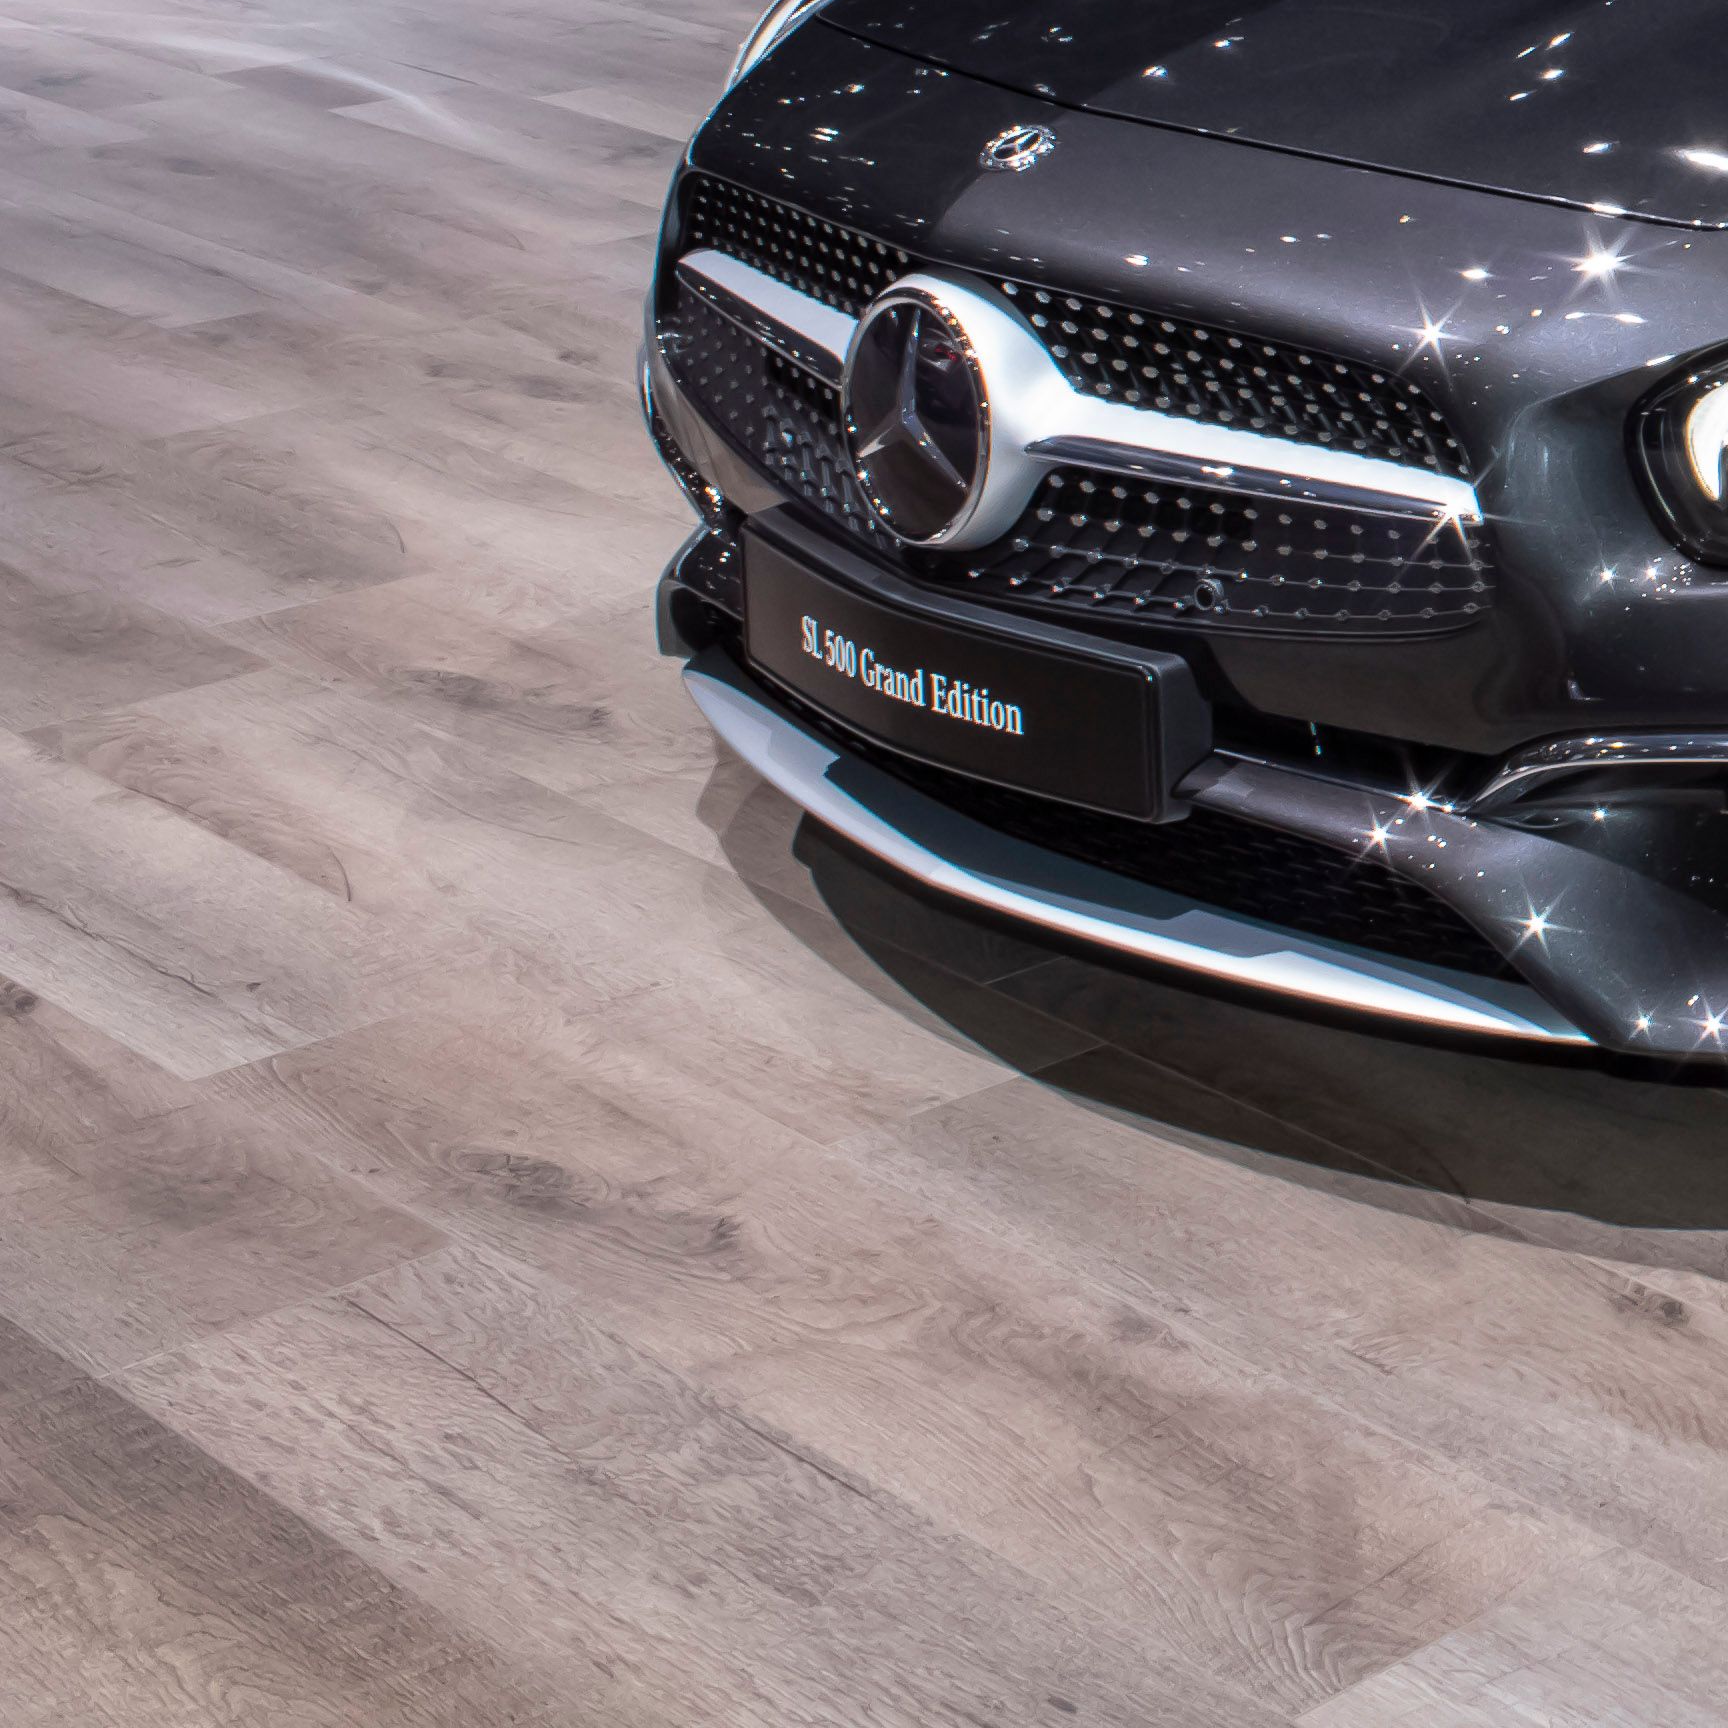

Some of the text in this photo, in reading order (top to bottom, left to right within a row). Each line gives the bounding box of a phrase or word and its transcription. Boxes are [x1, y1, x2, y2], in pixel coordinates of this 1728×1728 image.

[802, 615, 1025, 736] SL 500 Grand Edition
